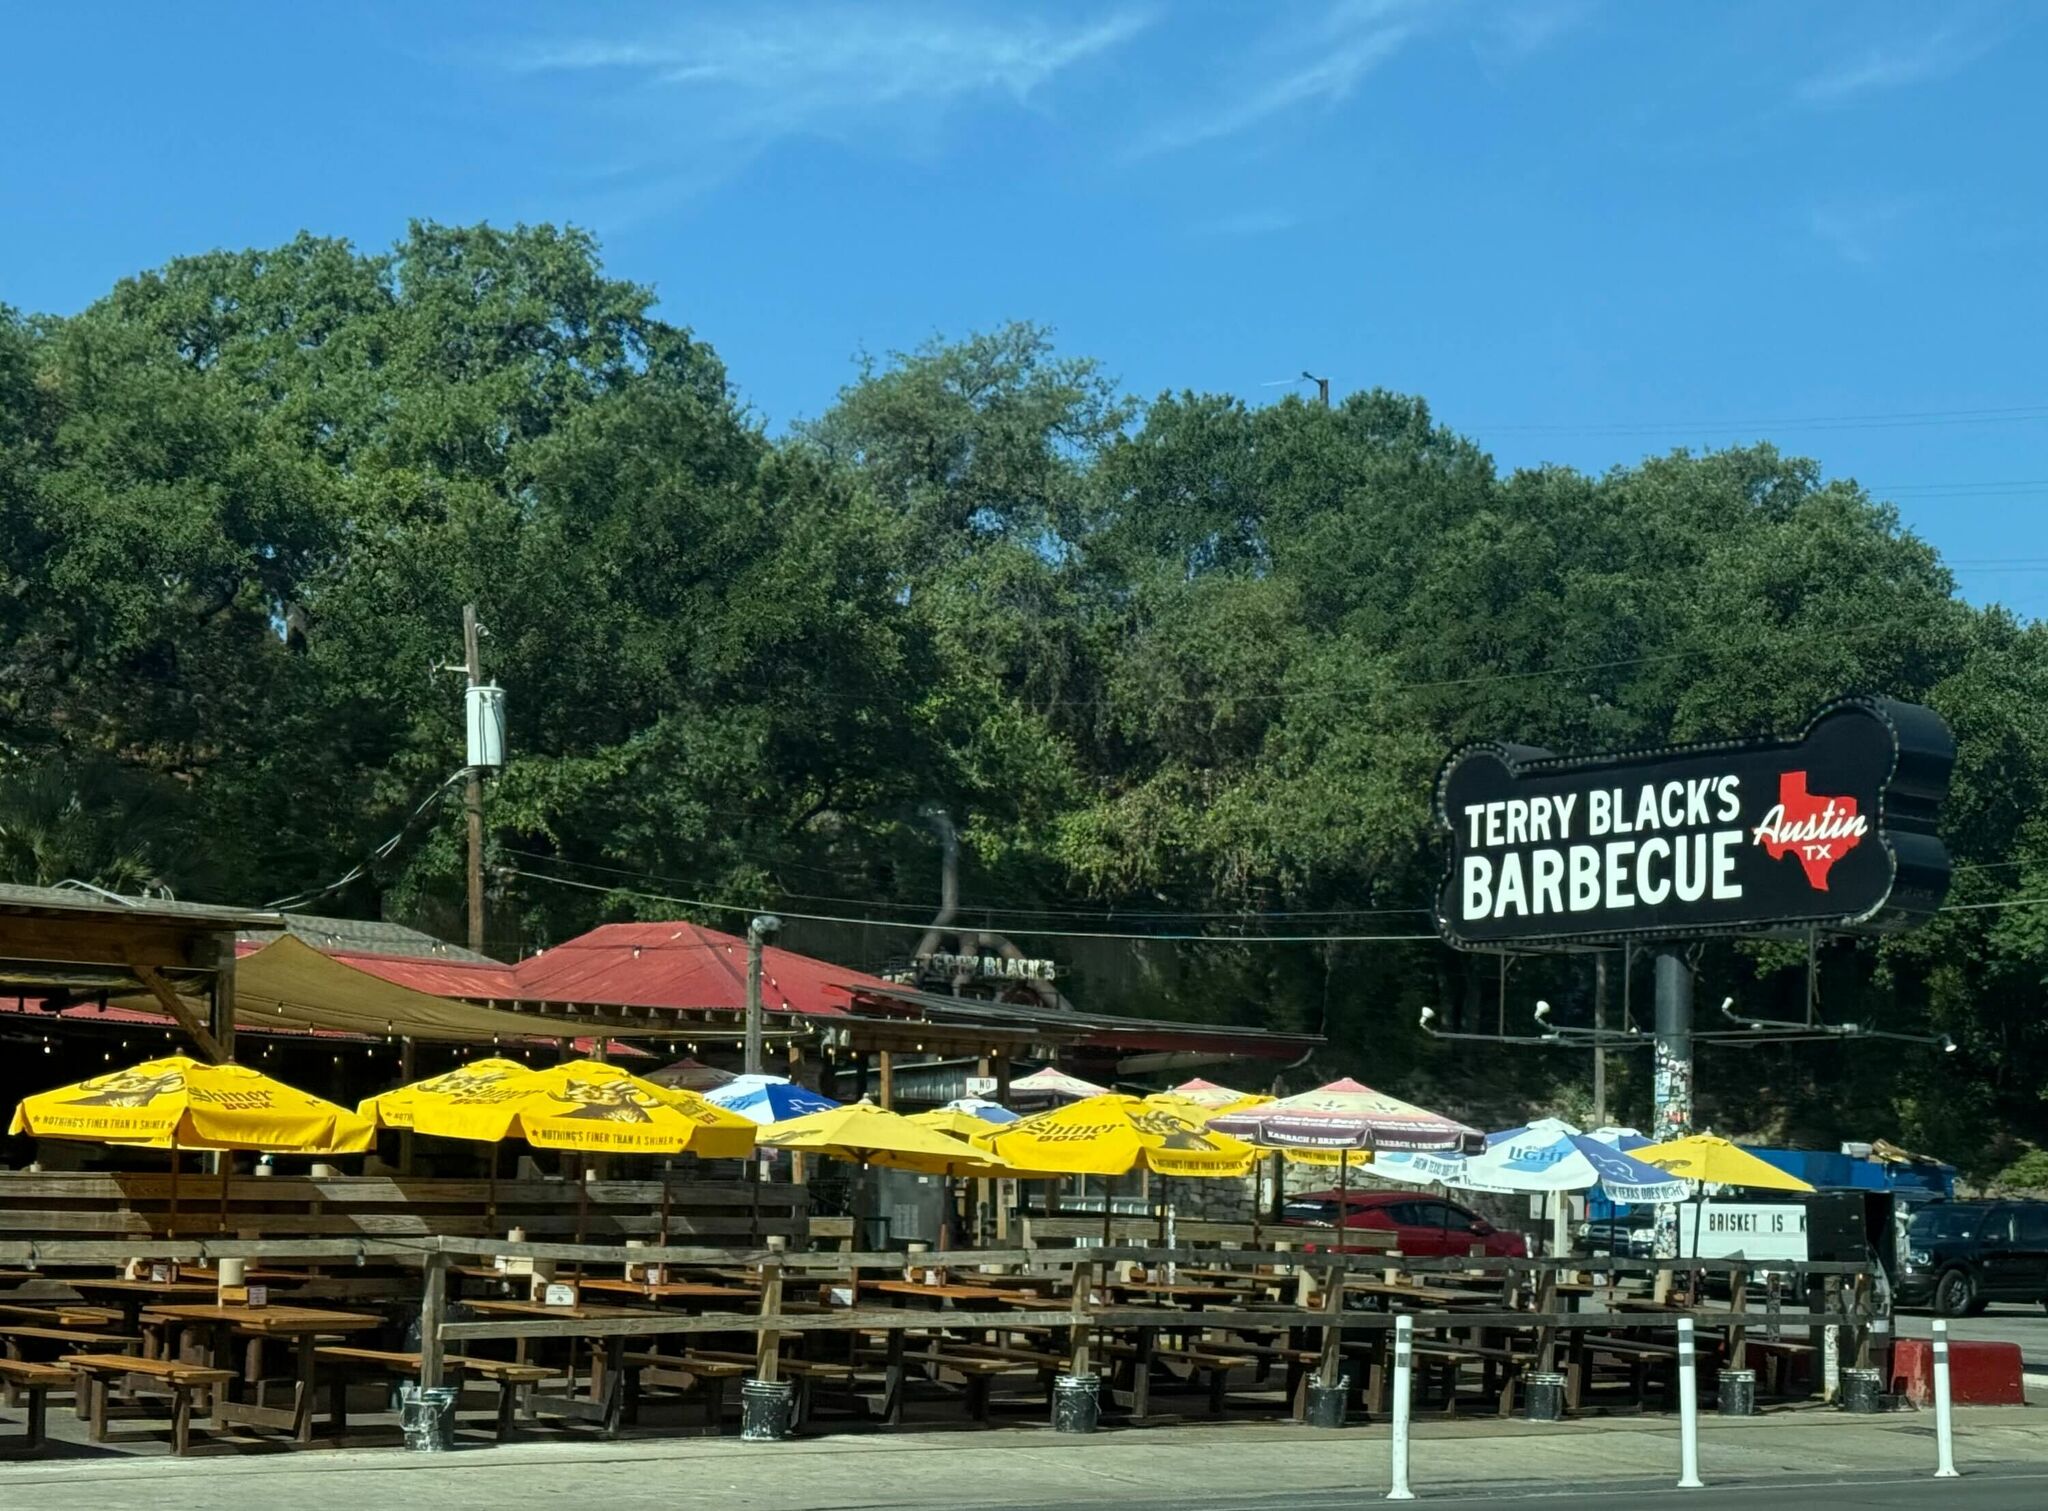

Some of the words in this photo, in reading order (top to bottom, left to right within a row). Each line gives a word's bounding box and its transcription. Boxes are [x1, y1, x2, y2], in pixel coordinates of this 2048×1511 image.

[1465, 793, 1577, 848] TERRY
[1589, 775, 1740, 836] BLACK'S
[1753, 800, 1868, 845] Austin
[1802, 844, 1832, 860] TX
[1463, 830, 1743, 920] BARBECUE
[1020, 1120, 1125, 1136] Shiner
[541, 1129, 583, 1142] NOTHING'S
[586, 1131, 609, 1143] FINER
[613, 1133, 634, 1145] THAN
[644, 1135, 674, 1146] SHINER
[1508, 1146, 1568, 1162] LIGHT
[1619, 1186, 1640, 1199] TEXAS
[1709, 1213, 1757, 1232] BRISKET
[1772, 1214, 1783, 1232] IS
